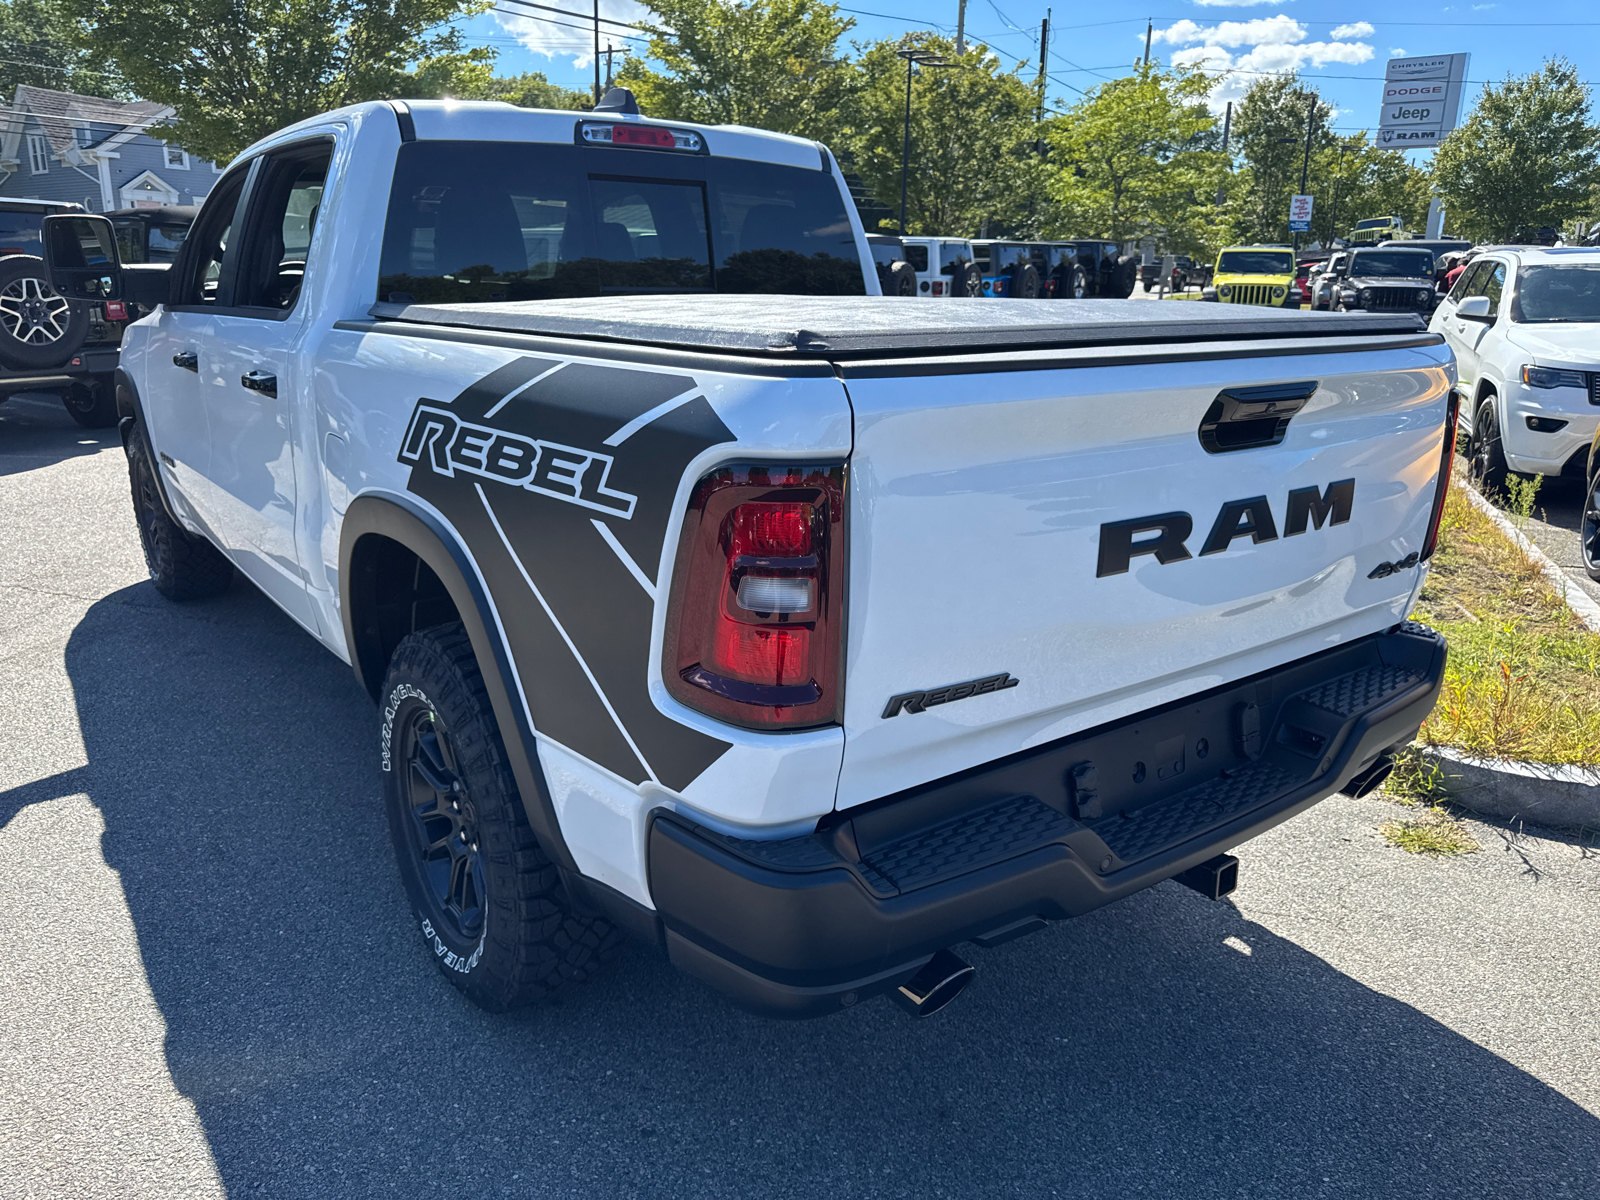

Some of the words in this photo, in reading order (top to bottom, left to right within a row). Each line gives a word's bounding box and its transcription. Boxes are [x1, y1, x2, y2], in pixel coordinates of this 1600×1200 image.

[1391, 61, 1445, 69] CHRYSLER
[1386, 86, 1442, 96] DODGE
[1391, 107, 1430, 120] Jeep
[401, 404, 638, 520] REBEL
[1096, 477, 1355, 578] RAM
[881, 672, 1020, 719] REBEL
